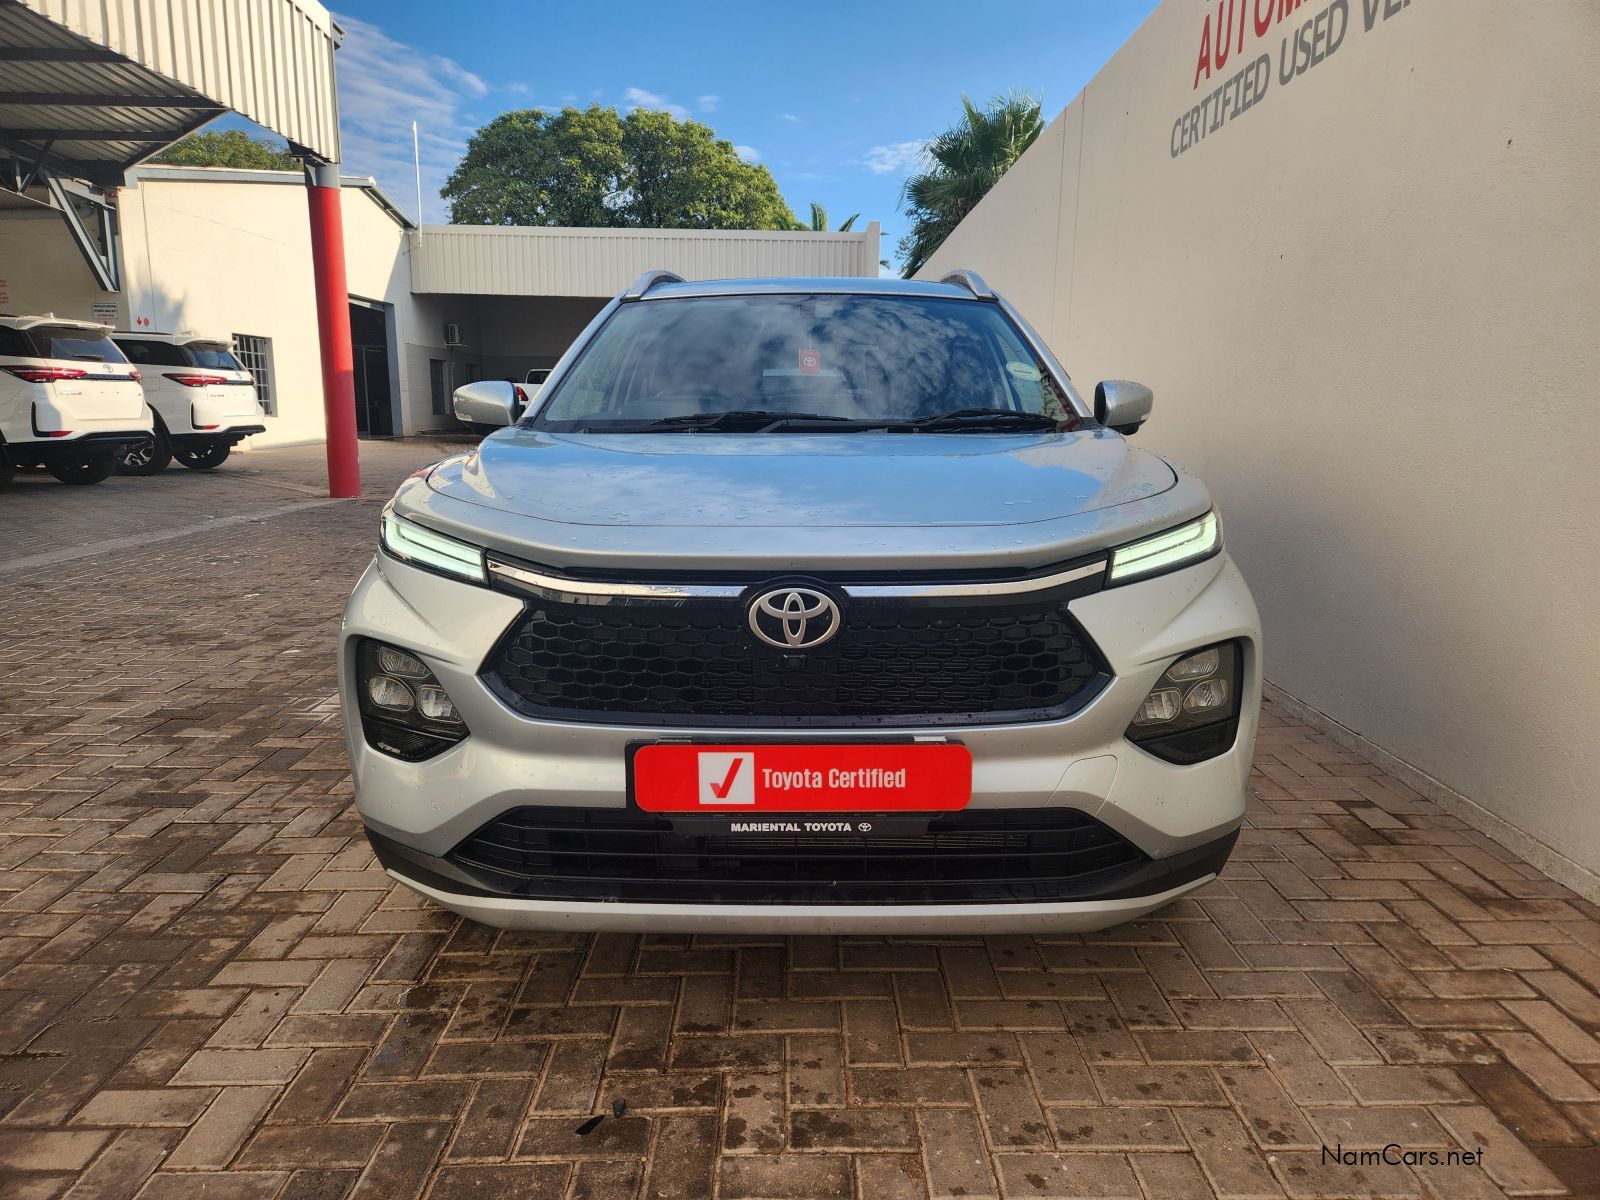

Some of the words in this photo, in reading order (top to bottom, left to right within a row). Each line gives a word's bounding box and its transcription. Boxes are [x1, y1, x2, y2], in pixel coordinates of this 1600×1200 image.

[1170, 53, 1271, 158] CERTIFIED
[1279, 0, 1349, 86] USED
[762, 768, 823, 791] Toyota
[828, 768, 906, 789] Certified
[730, 822, 801, 832] MARIENTAL
[804, 822, 852, 832] TOYOTA
